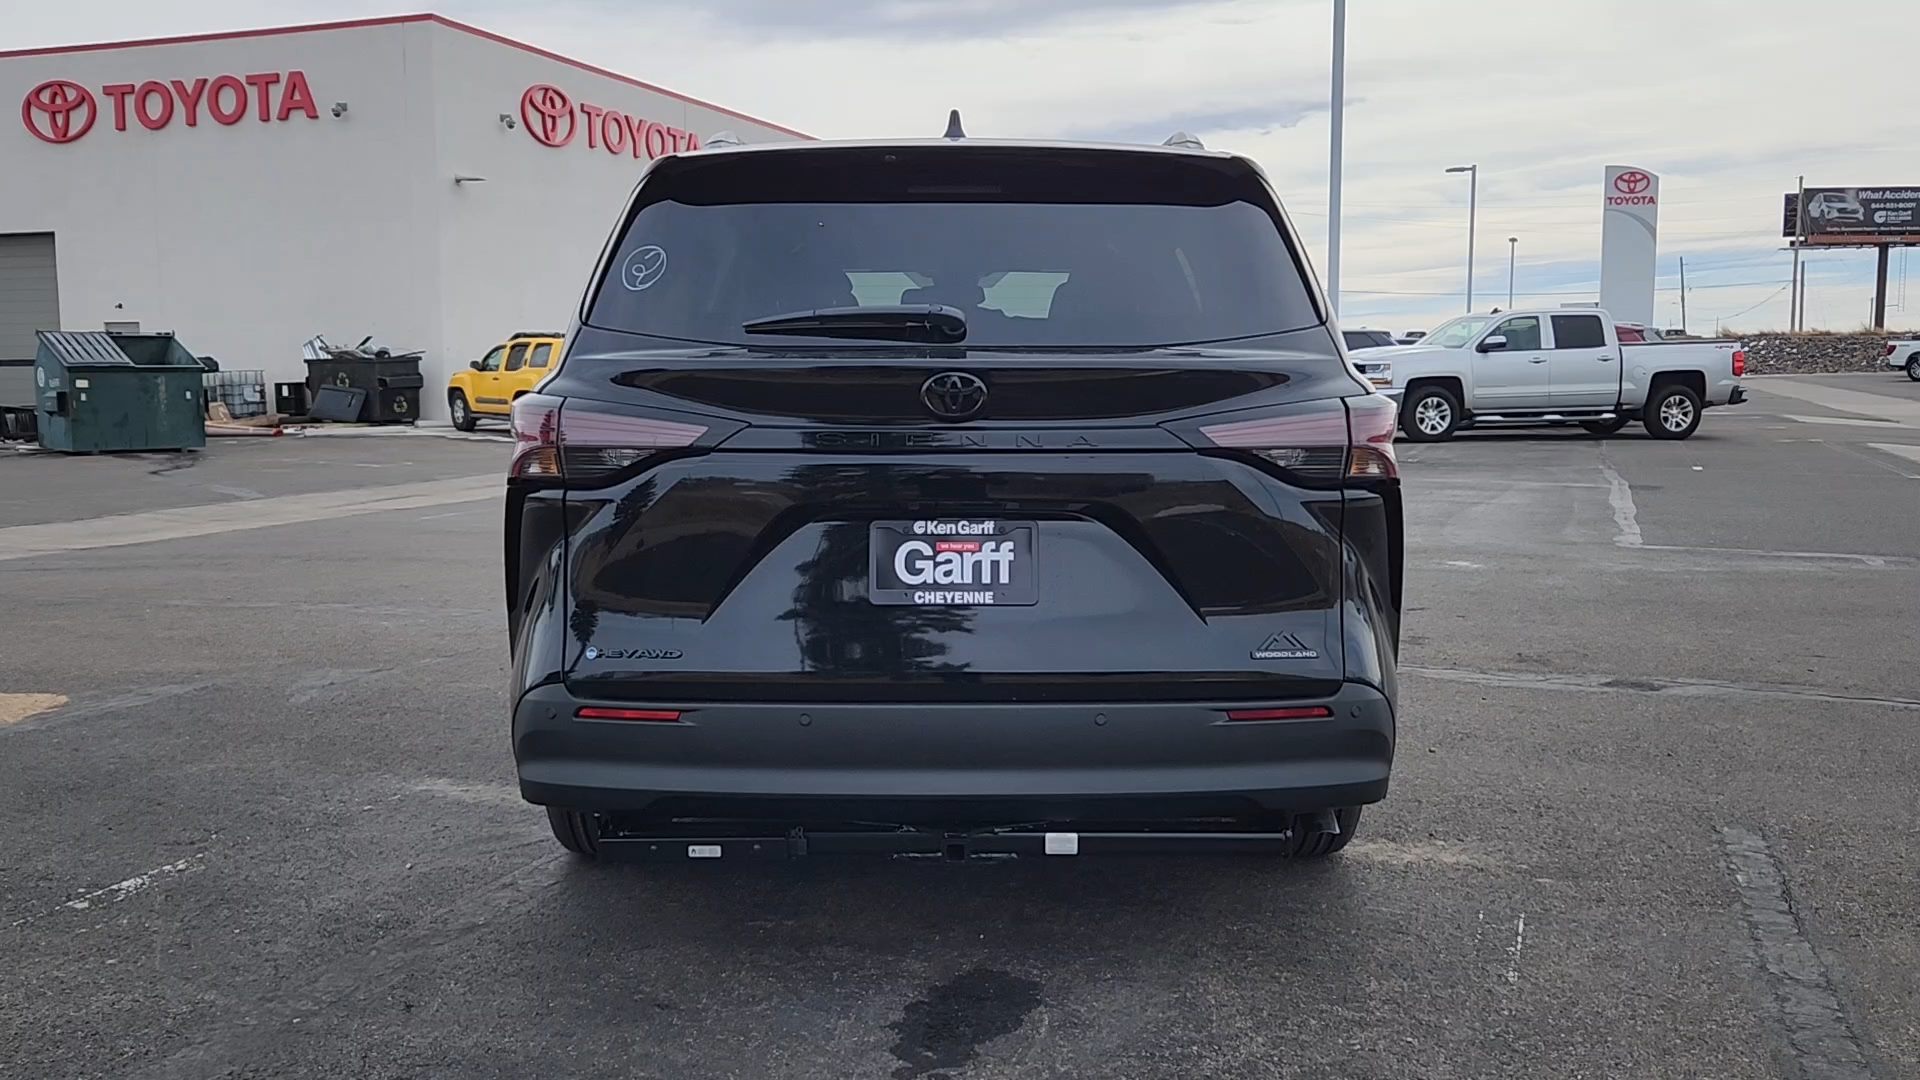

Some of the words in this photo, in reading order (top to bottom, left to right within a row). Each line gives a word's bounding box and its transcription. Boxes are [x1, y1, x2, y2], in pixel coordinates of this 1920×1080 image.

[102, 71, 319, 131] TOYOTA
[1607, 195, 1656, 205] TOYOTA
[1858, 190, 1883, 199] What
[815, 431, 1098, 447] SIENNA
[927, 520, 956, 534] Ken
[957, 520, 995, 534] Garff
[963, 543, 975, 551] you
[894, 540, 1014, 585] Garff
[914, 591, 994, 604] CHEYENNE
